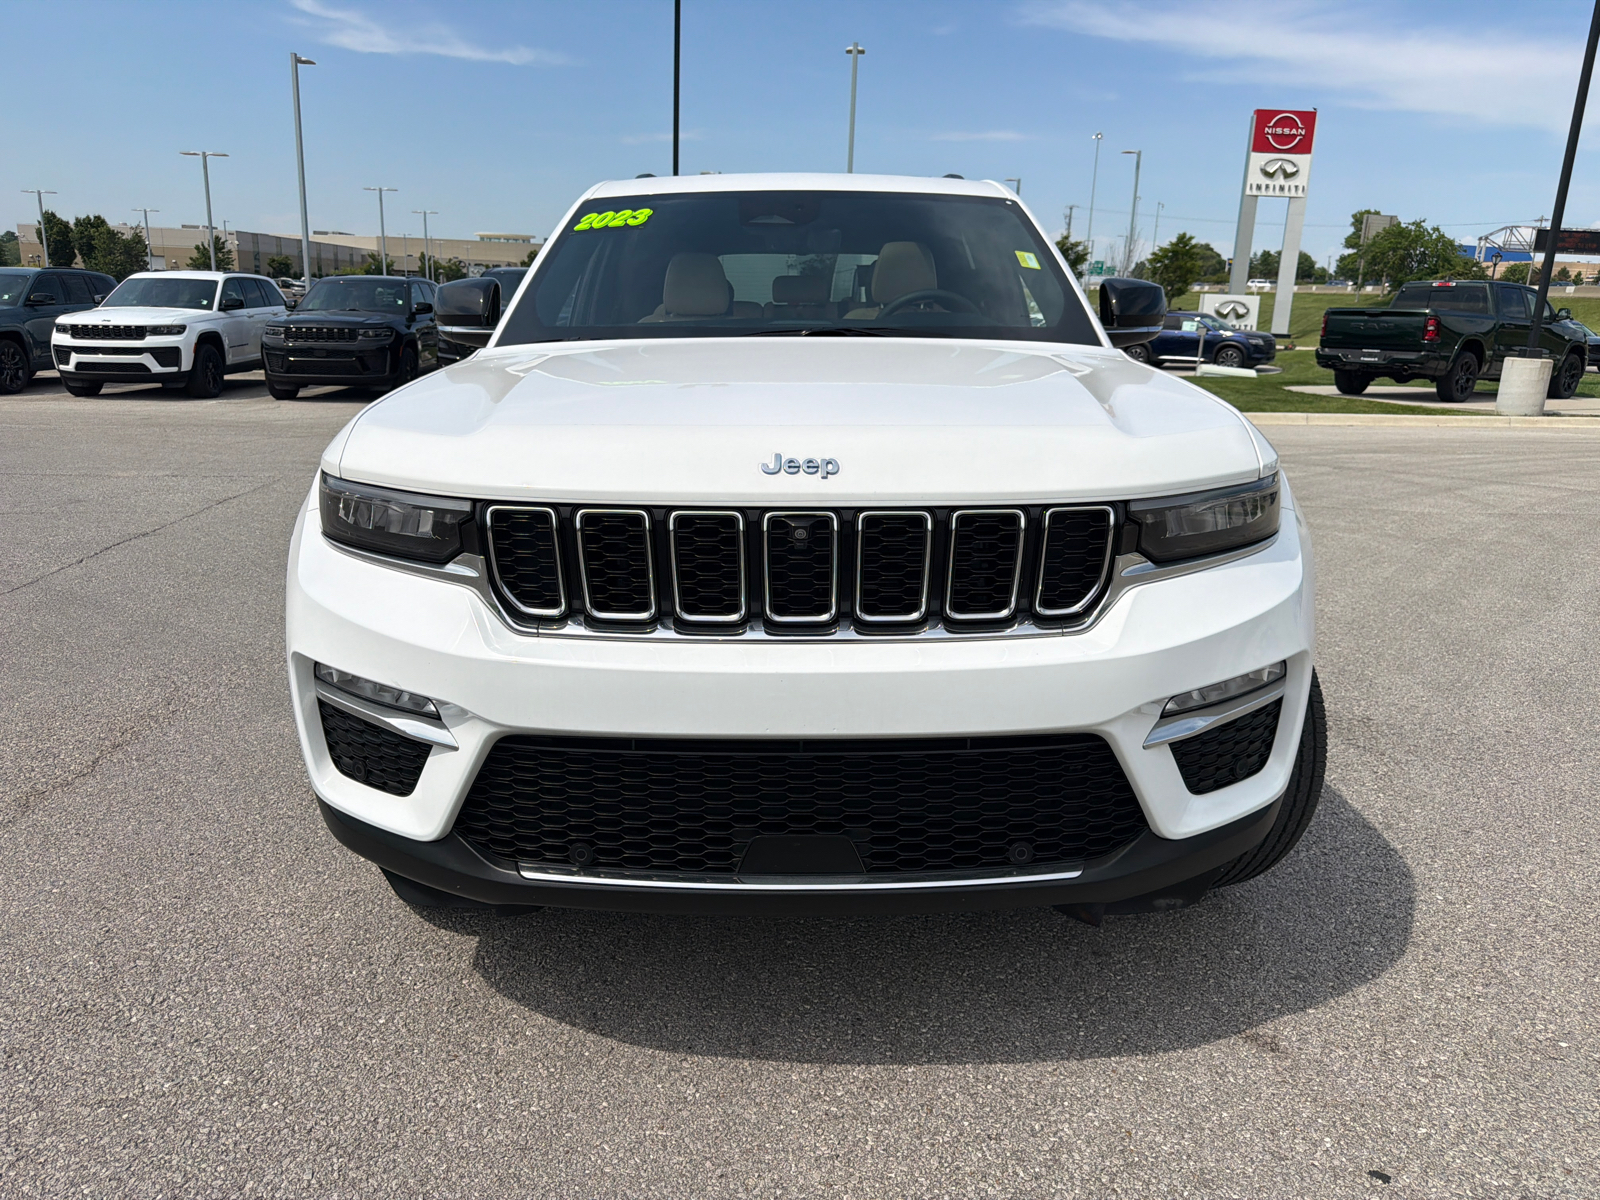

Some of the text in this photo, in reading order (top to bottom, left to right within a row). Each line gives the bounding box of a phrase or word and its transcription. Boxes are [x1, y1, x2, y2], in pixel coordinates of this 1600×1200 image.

[1264, 126, 1306, 136] NISSAN
[1249, 182, 1306, 193] INFINITI
[573, 208, 654, 231] 2023
[760, 452, 840, 480] Jeep
